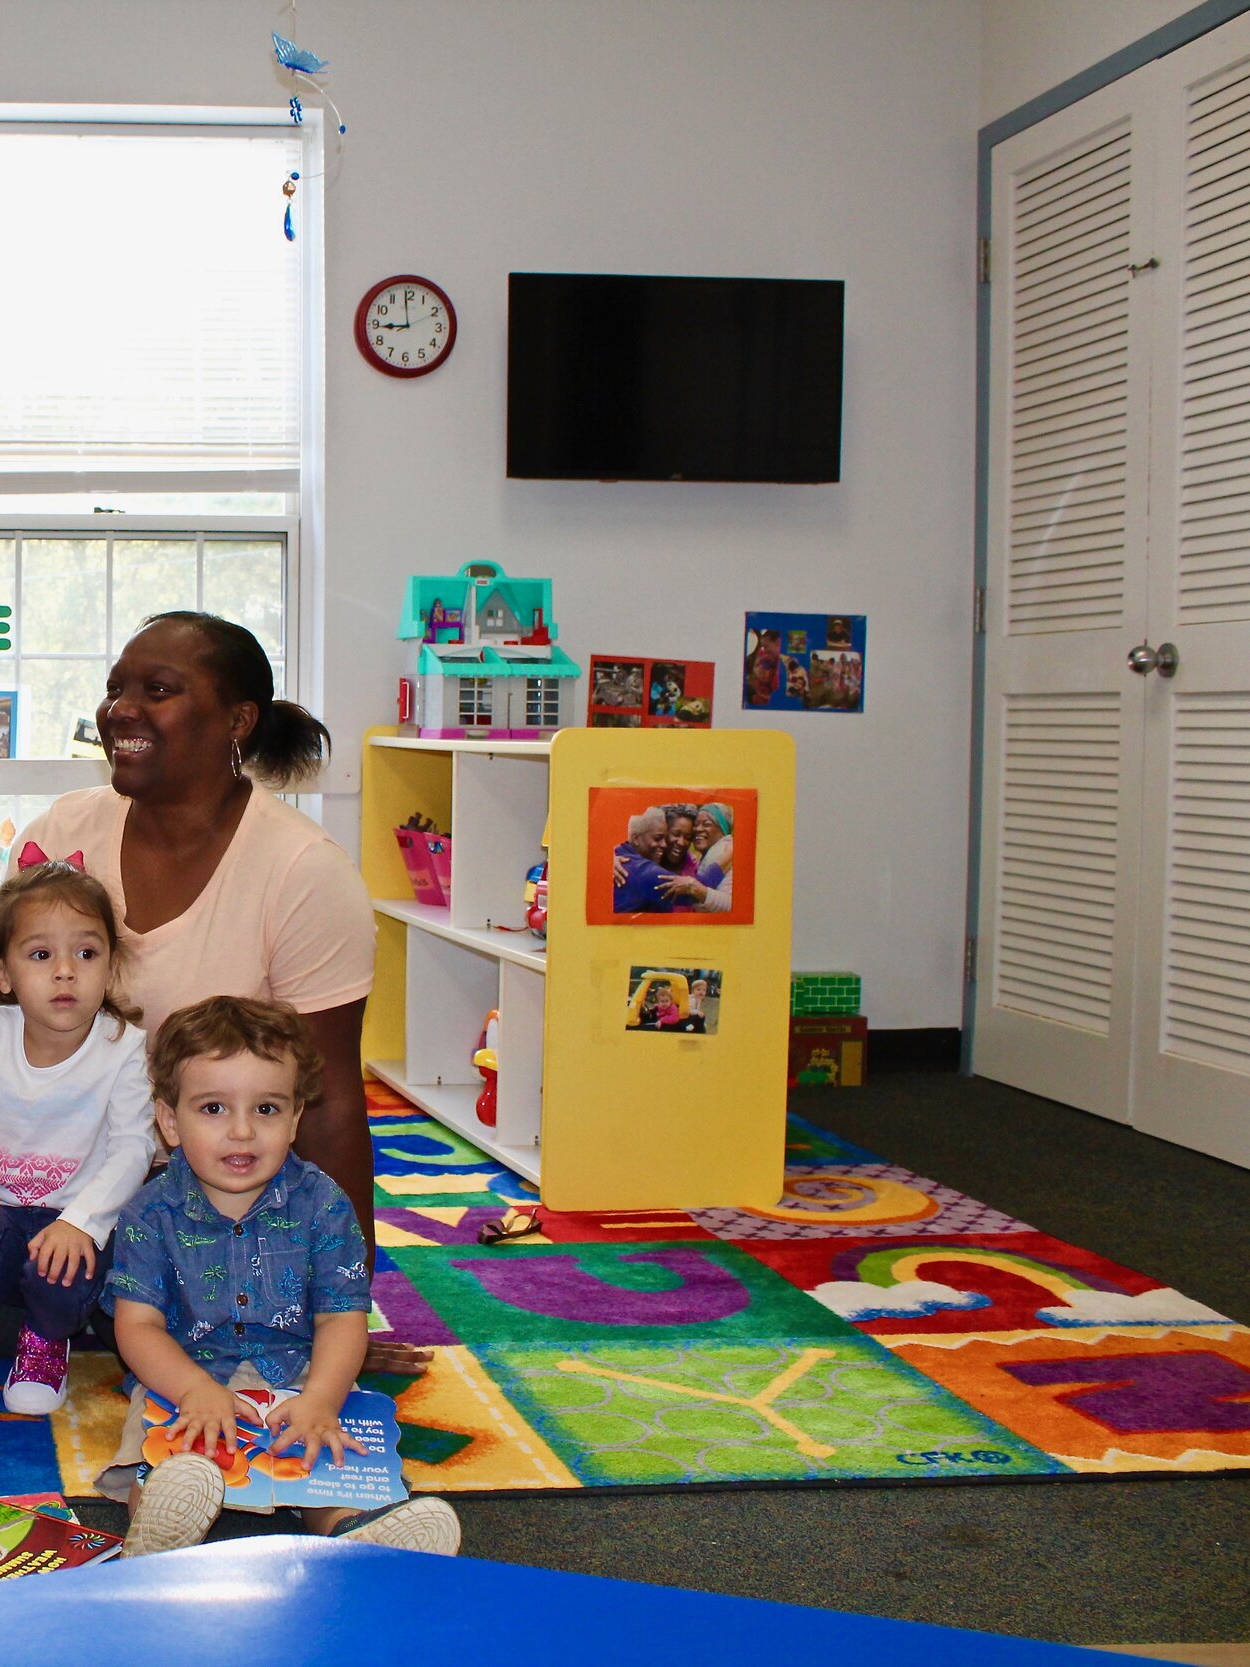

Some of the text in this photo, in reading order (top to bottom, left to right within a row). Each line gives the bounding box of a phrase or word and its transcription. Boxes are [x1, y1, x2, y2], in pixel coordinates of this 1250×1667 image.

[389, 293, 396, 304] 11
[377, 304, 388, 315] 10
[430, 306, 439, 317] 2
[372, 319, 380, 329] 9
[434, 322, 443, 333] 3
[375, 335, 384, 346] 8
[429, 337, 437, 348] 4
[387, 346, 394, 357] 7
[417, 348, 426, 359] 5
[401, 351, 410, 363] 6
[358, 1418, 383, 1426] with
[366, 1426, 384, 1435] toy
[368, 1445, 386, 1453] Do
[362, 1466, 389, 1474] your
[309, 1478, 341, 1488] sleep
[341, 1473, 389, 1483] and rest
[307, 1487, 334, 1497] time
[378, 1484, 391, 1492] to
[355, 1491, 392, 1501] When
